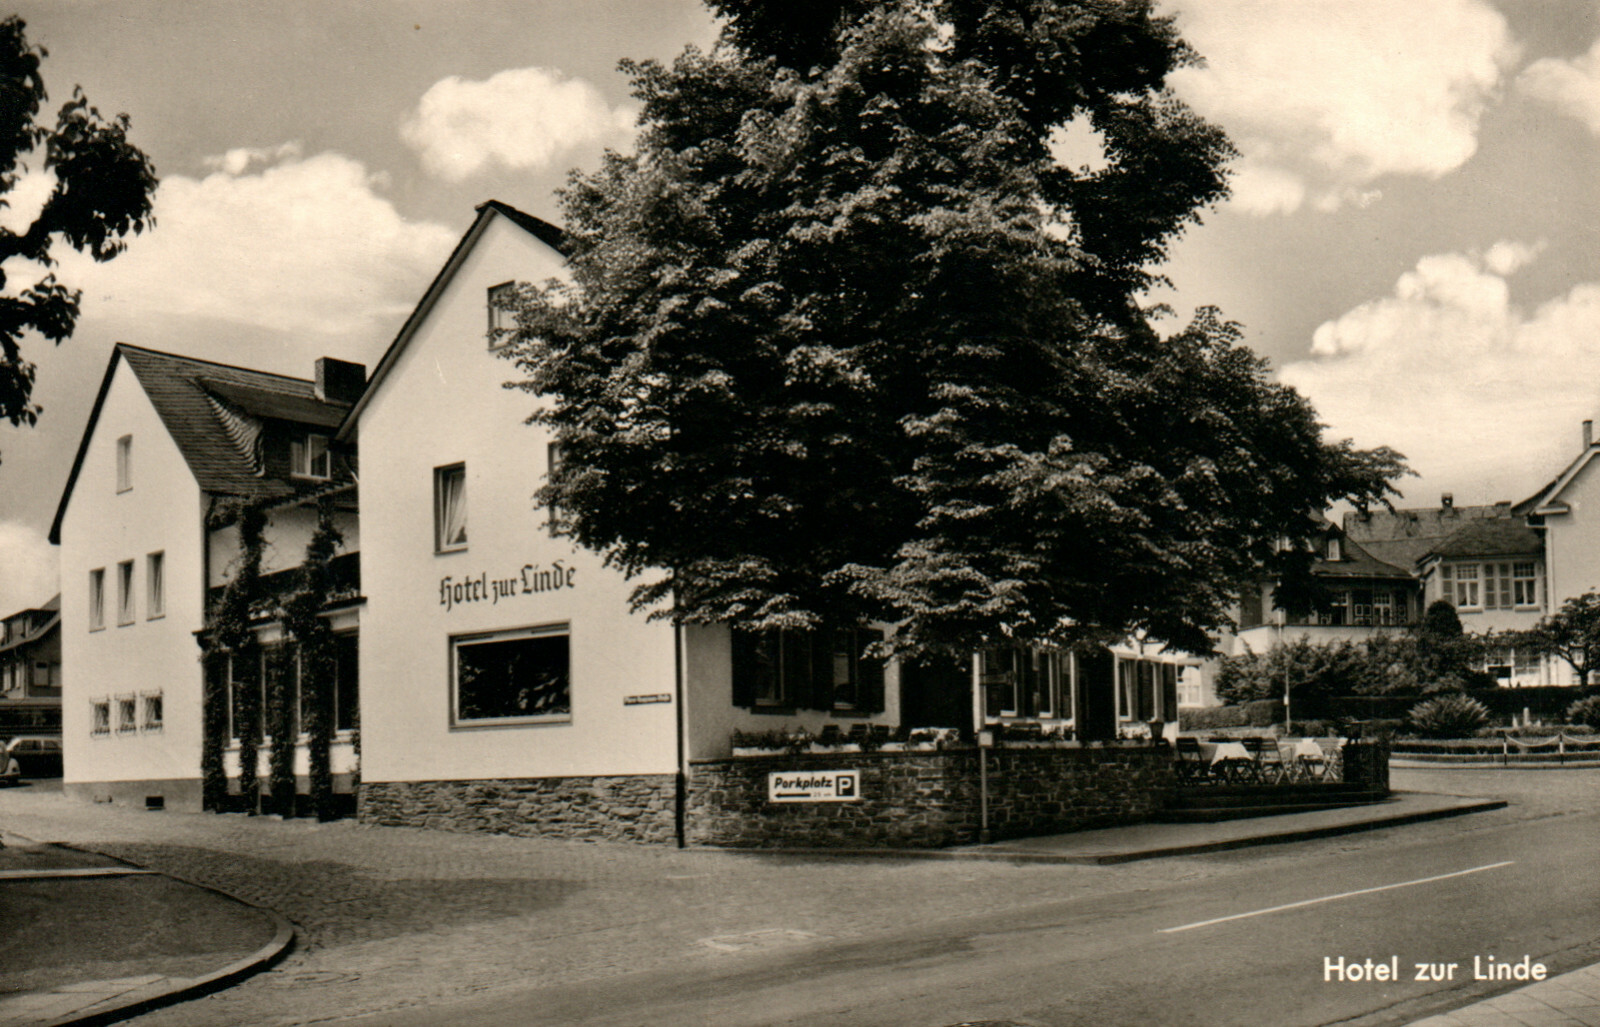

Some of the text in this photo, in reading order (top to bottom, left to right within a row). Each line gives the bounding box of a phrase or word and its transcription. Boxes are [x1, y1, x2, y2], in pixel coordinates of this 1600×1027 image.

[440, 559, 576, 612] Hotel zur Linde
[774, 776, 833, 790] Parkplatz
[838, 777, 852, 796] P
